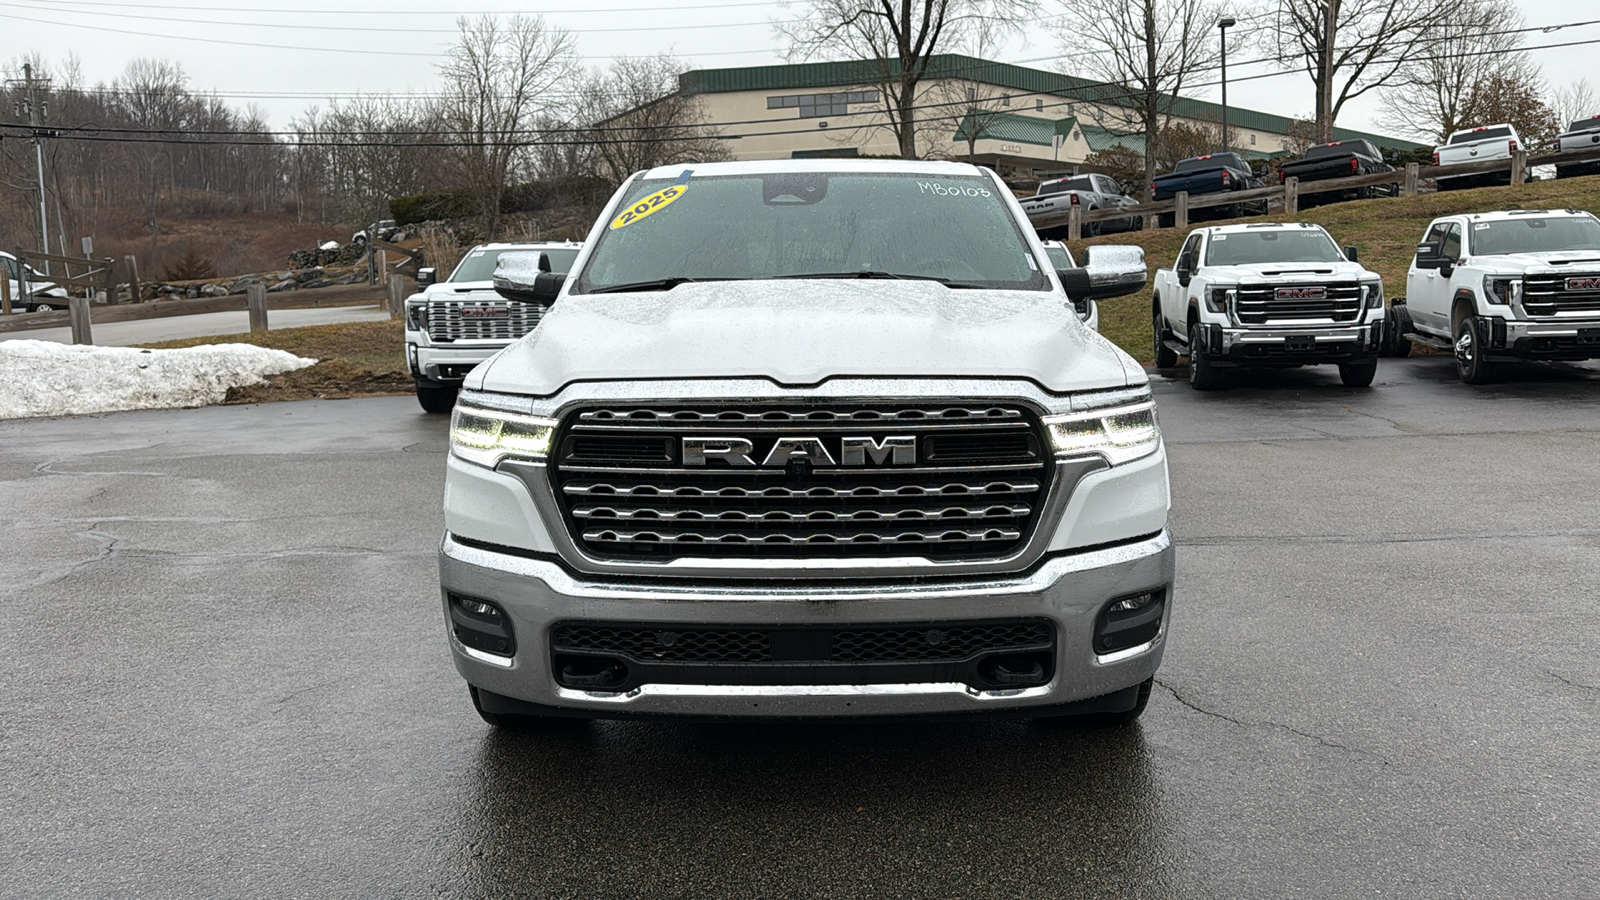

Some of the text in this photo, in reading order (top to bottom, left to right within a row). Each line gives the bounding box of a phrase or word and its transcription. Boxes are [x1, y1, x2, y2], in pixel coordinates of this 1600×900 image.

[620, 187, 679, 224] 2025
[1026, 202, 1055, 211] RAM
[1570, 279, 1600, 289] GM
[1278, 288, 1324, 298] GMC
[462, 307, 508, 318] GMC
[682, 436, 917, 466] RAM
